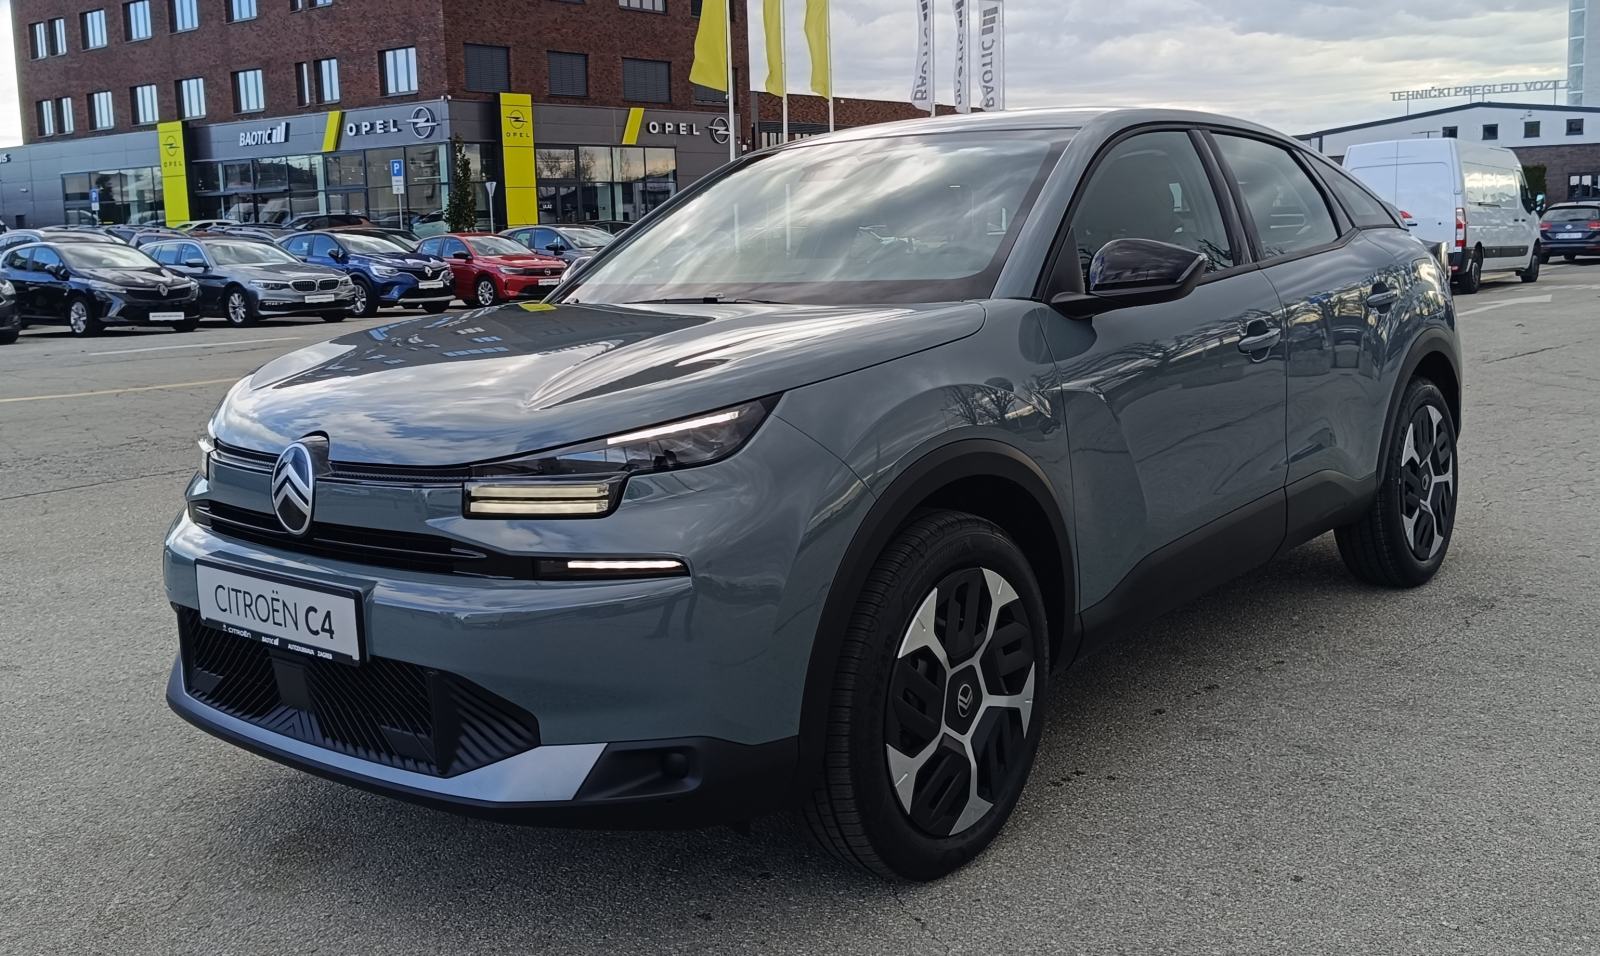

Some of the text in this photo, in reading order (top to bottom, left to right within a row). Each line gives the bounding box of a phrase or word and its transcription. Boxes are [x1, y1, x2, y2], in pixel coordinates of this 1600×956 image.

[1390, 86, 1451, 101] TEHNIČKI
[1454, 82, 1519, 97] PREGLED
[346, 118, 398, 136] OPEL
[649, 121, 700, 135] OPEL
[239, 128, 271, 146] BAOTIĆ
[393, 162, 400, 174] P
[215, 585, 335, 640] CITROËN C4
